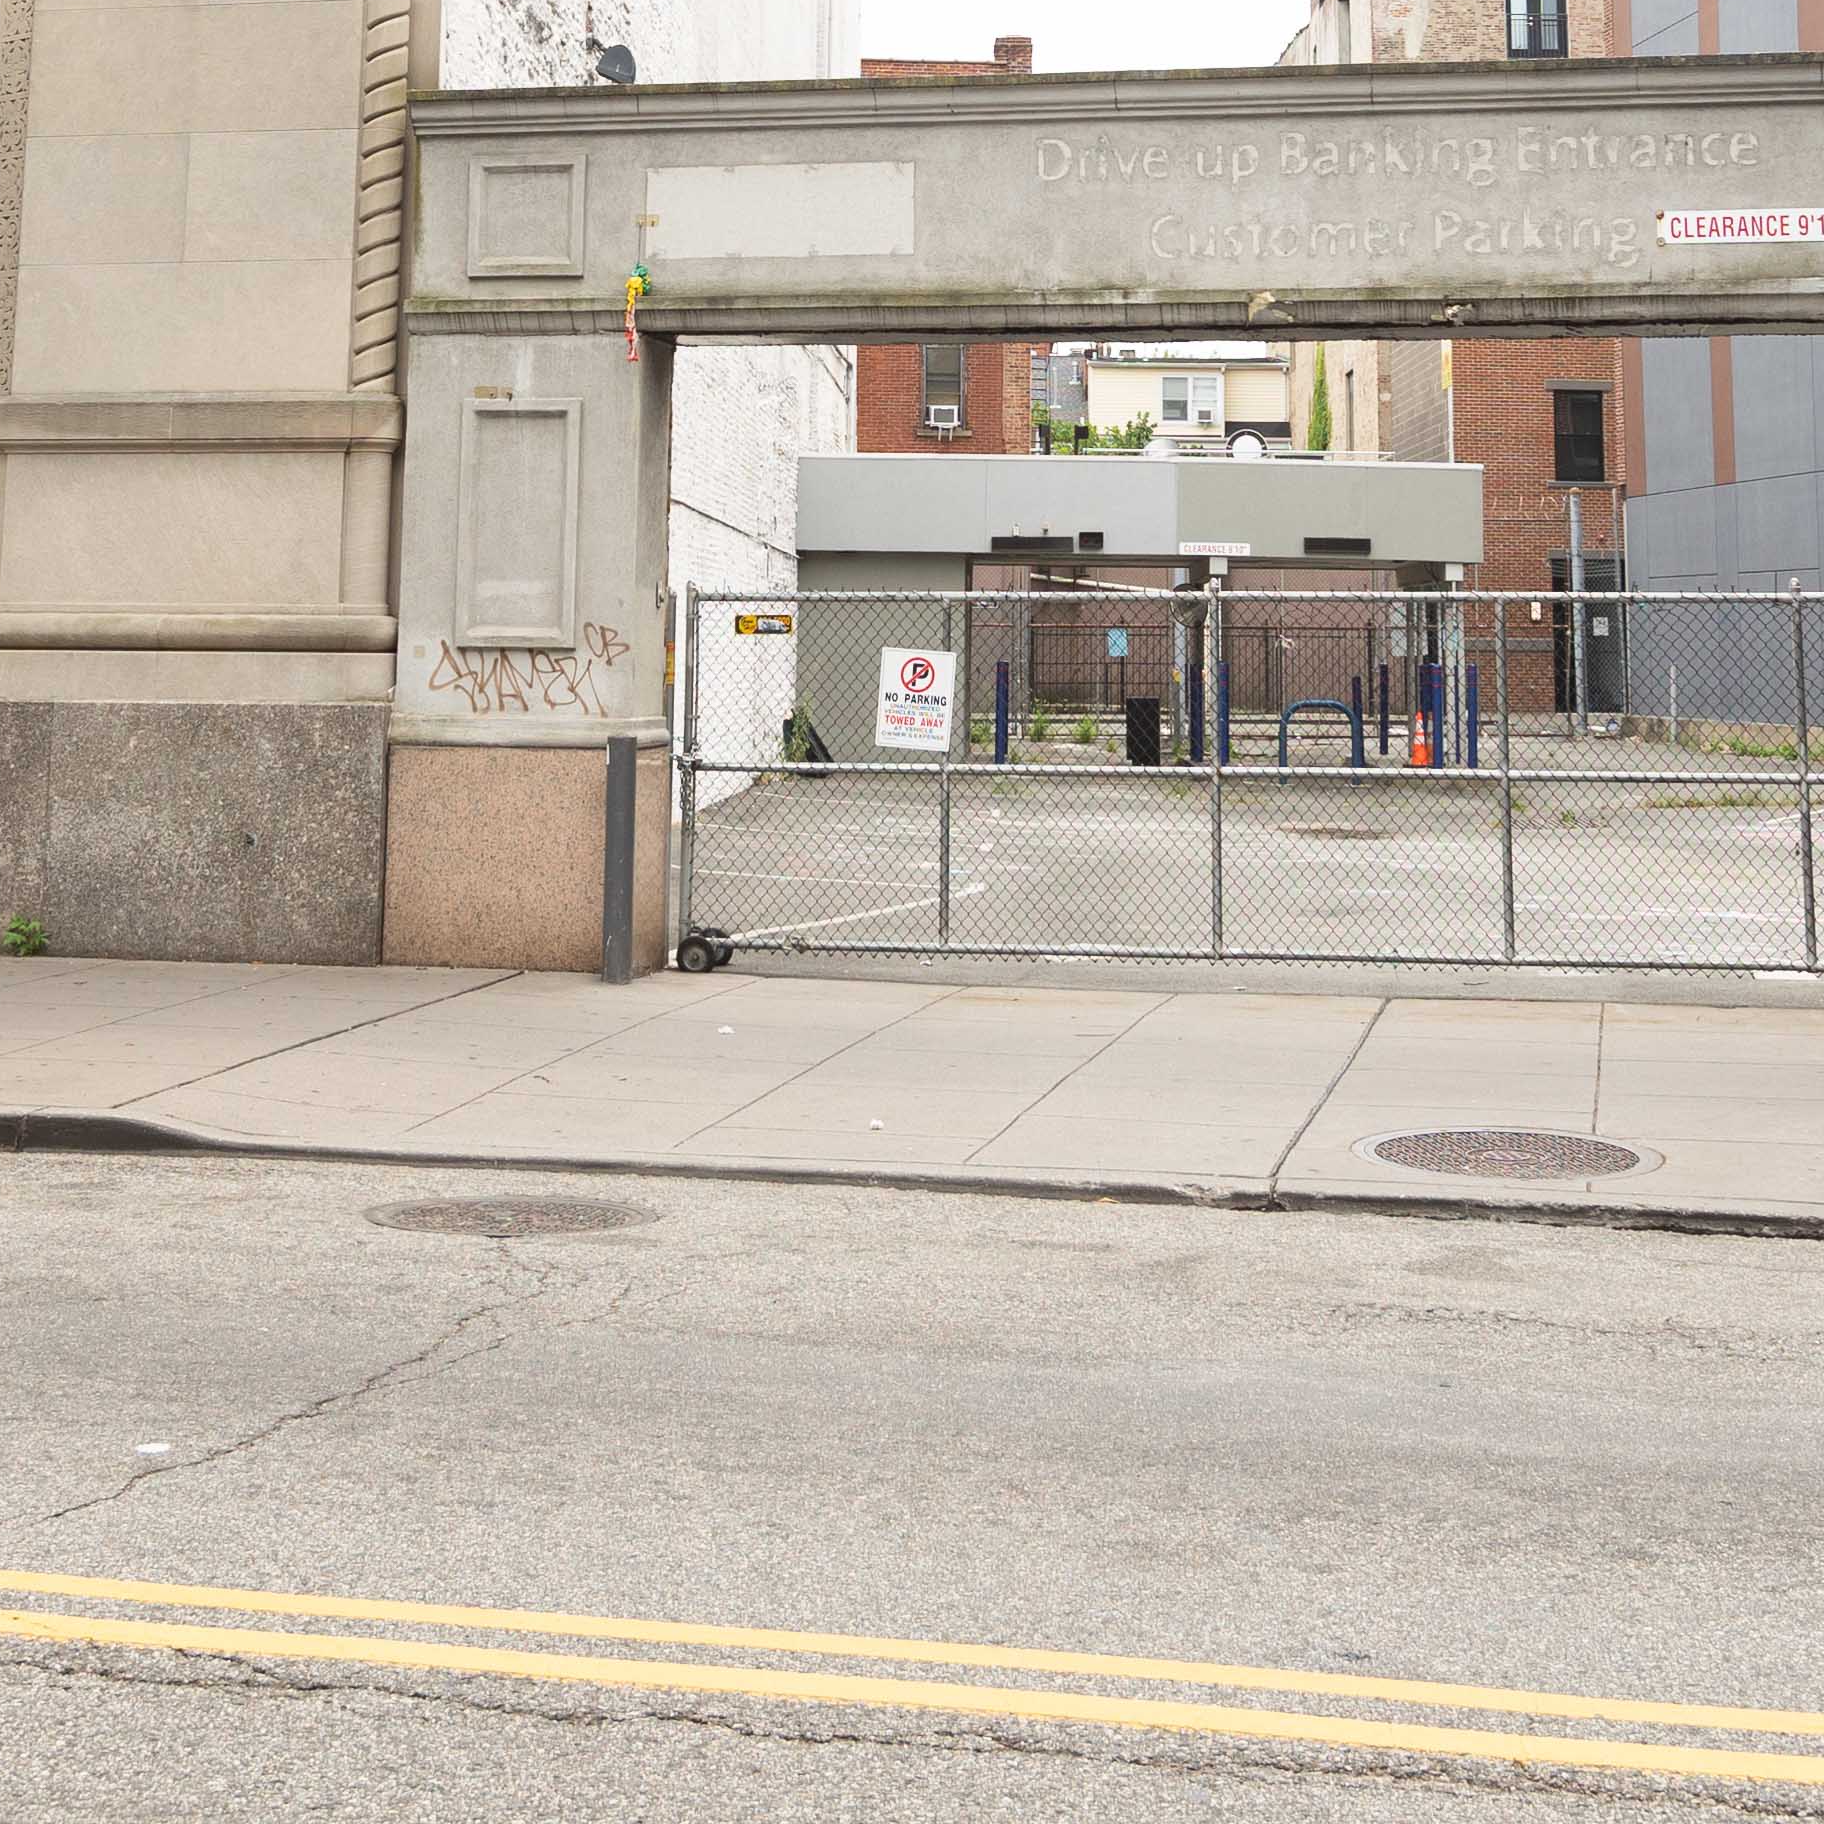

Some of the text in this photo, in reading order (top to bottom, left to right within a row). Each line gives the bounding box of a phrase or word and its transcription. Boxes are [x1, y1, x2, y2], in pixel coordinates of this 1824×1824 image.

[1035, 126, 1760, 187] Drive up Banking Entrance
[1669, 215, 1790, 239] CLEARANCE
[1150, 207, 1641, 268] Customer Parking
[1183, 544, 1225, 554] CLEARANCE
[884, 692, 947, 706] NO PARKING
[885, 715, 945, 728] TOWED AWAY
